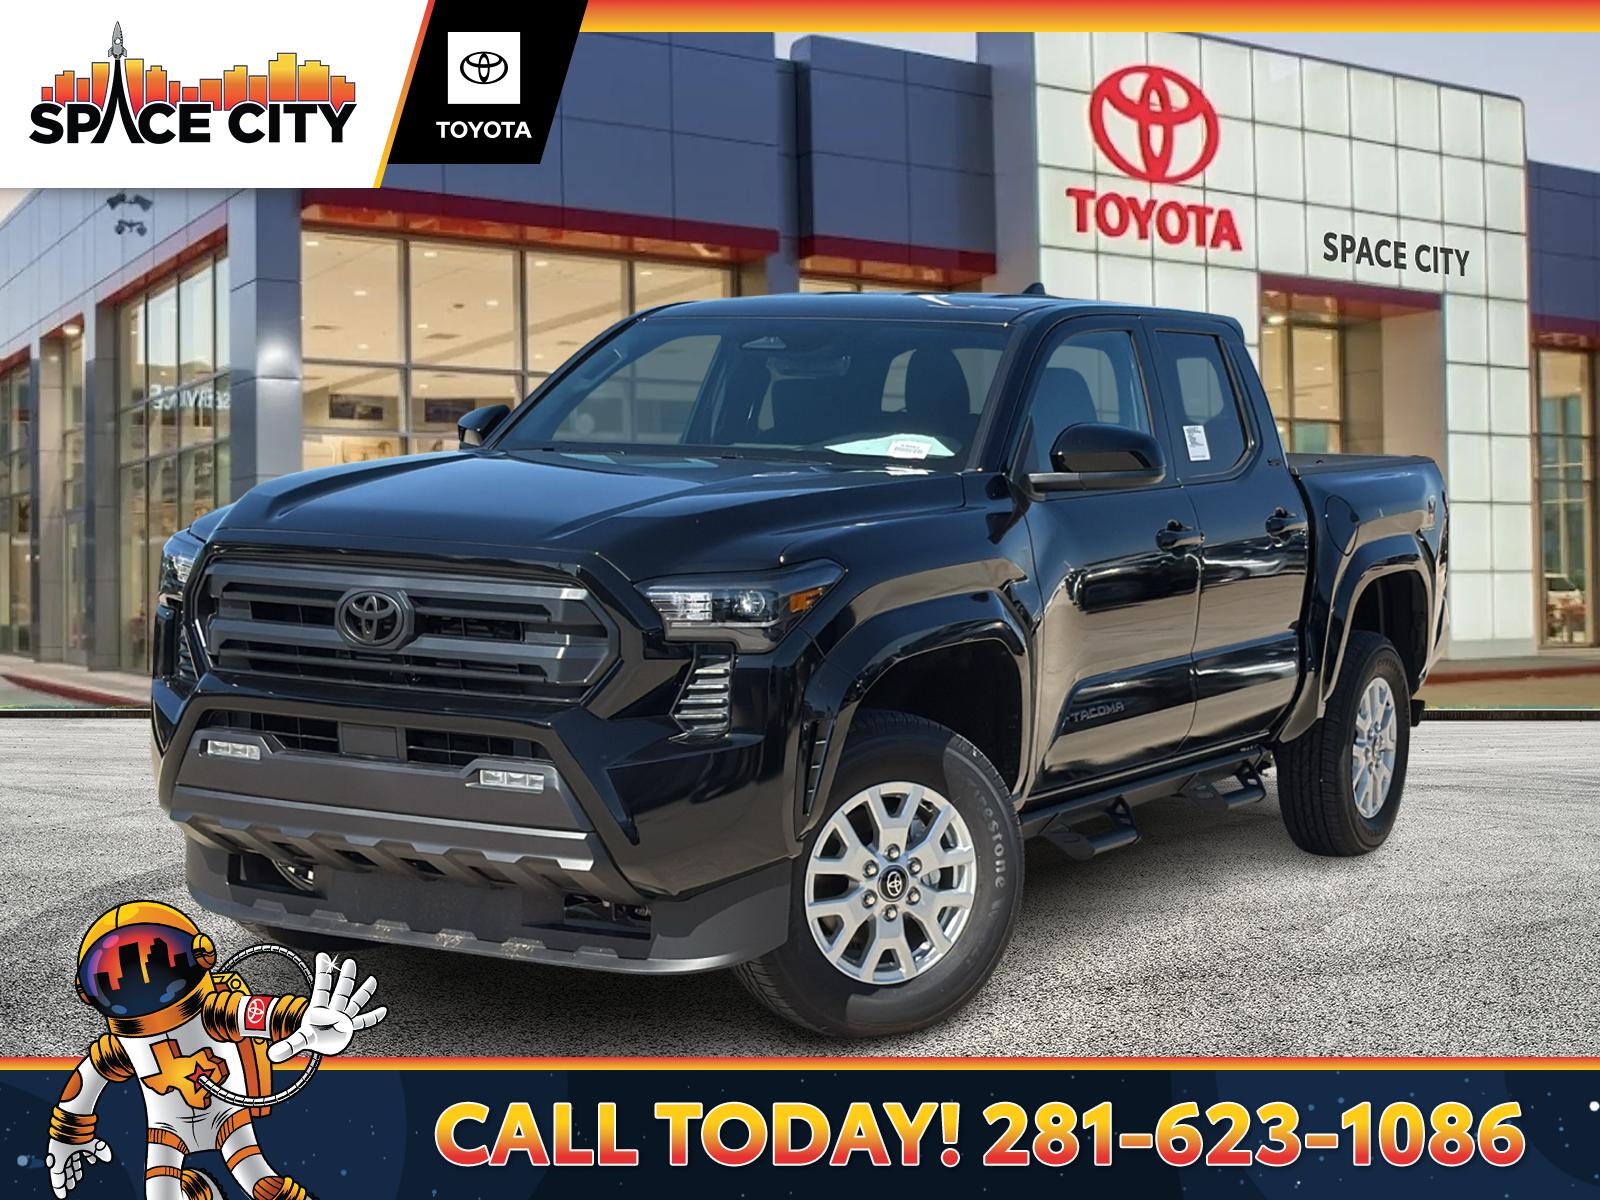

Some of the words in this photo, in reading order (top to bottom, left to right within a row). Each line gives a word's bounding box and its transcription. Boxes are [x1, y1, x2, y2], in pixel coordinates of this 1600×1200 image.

[1066, 188, 1242, 251] TOYOTA
[1323, 232, 1407, 270] SPACE
[1414, 245, 1470, 277] CITY
[1070, 702, 1125, 722] TACOMA
